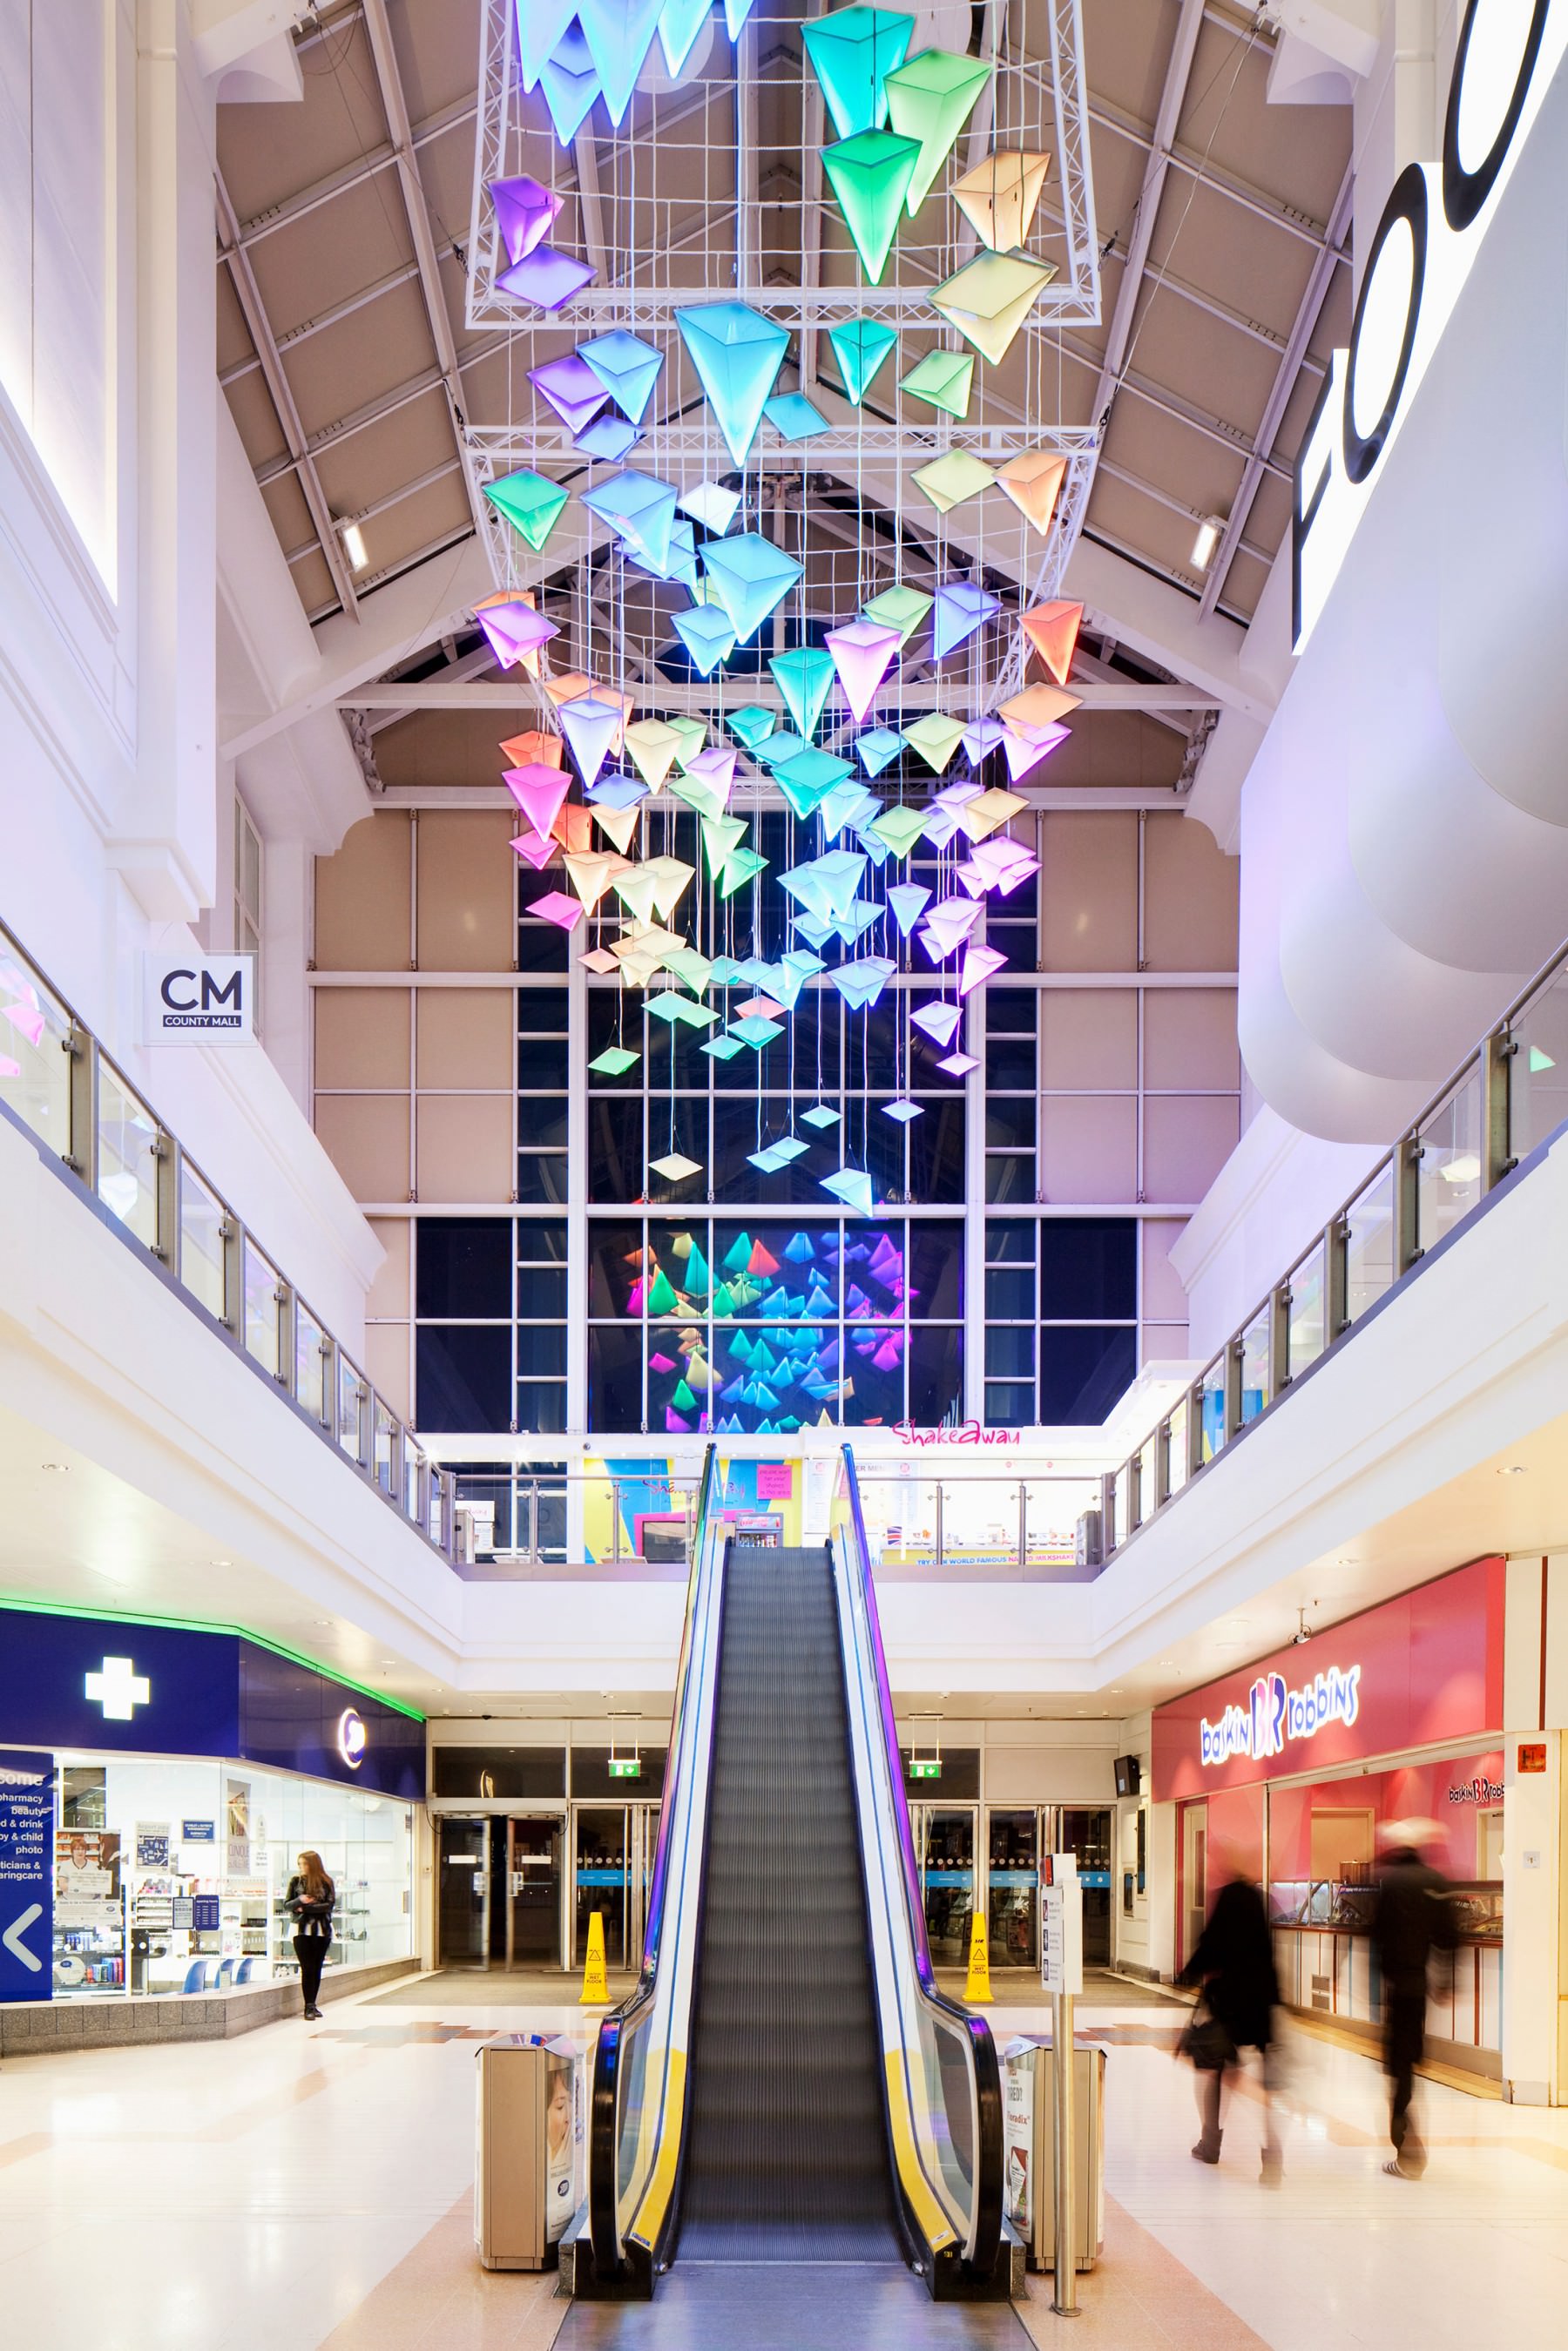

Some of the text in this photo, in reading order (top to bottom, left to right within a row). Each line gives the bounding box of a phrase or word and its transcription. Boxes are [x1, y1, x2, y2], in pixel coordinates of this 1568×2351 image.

[160, 969, 242, 1011] CM
[165, 1017, 240, 1026] COUNTY MALL
[1201, 1665, 1361, 1766] baskin BR robbins
[1449, 1784, 1473, 1802] baskin
[11, 1806, 43, 1816] beauty
[10, 1819, 17, 1827] &
[19, 1819, 44, 1827] drink
[16, 1846, 43, 1854] photo
